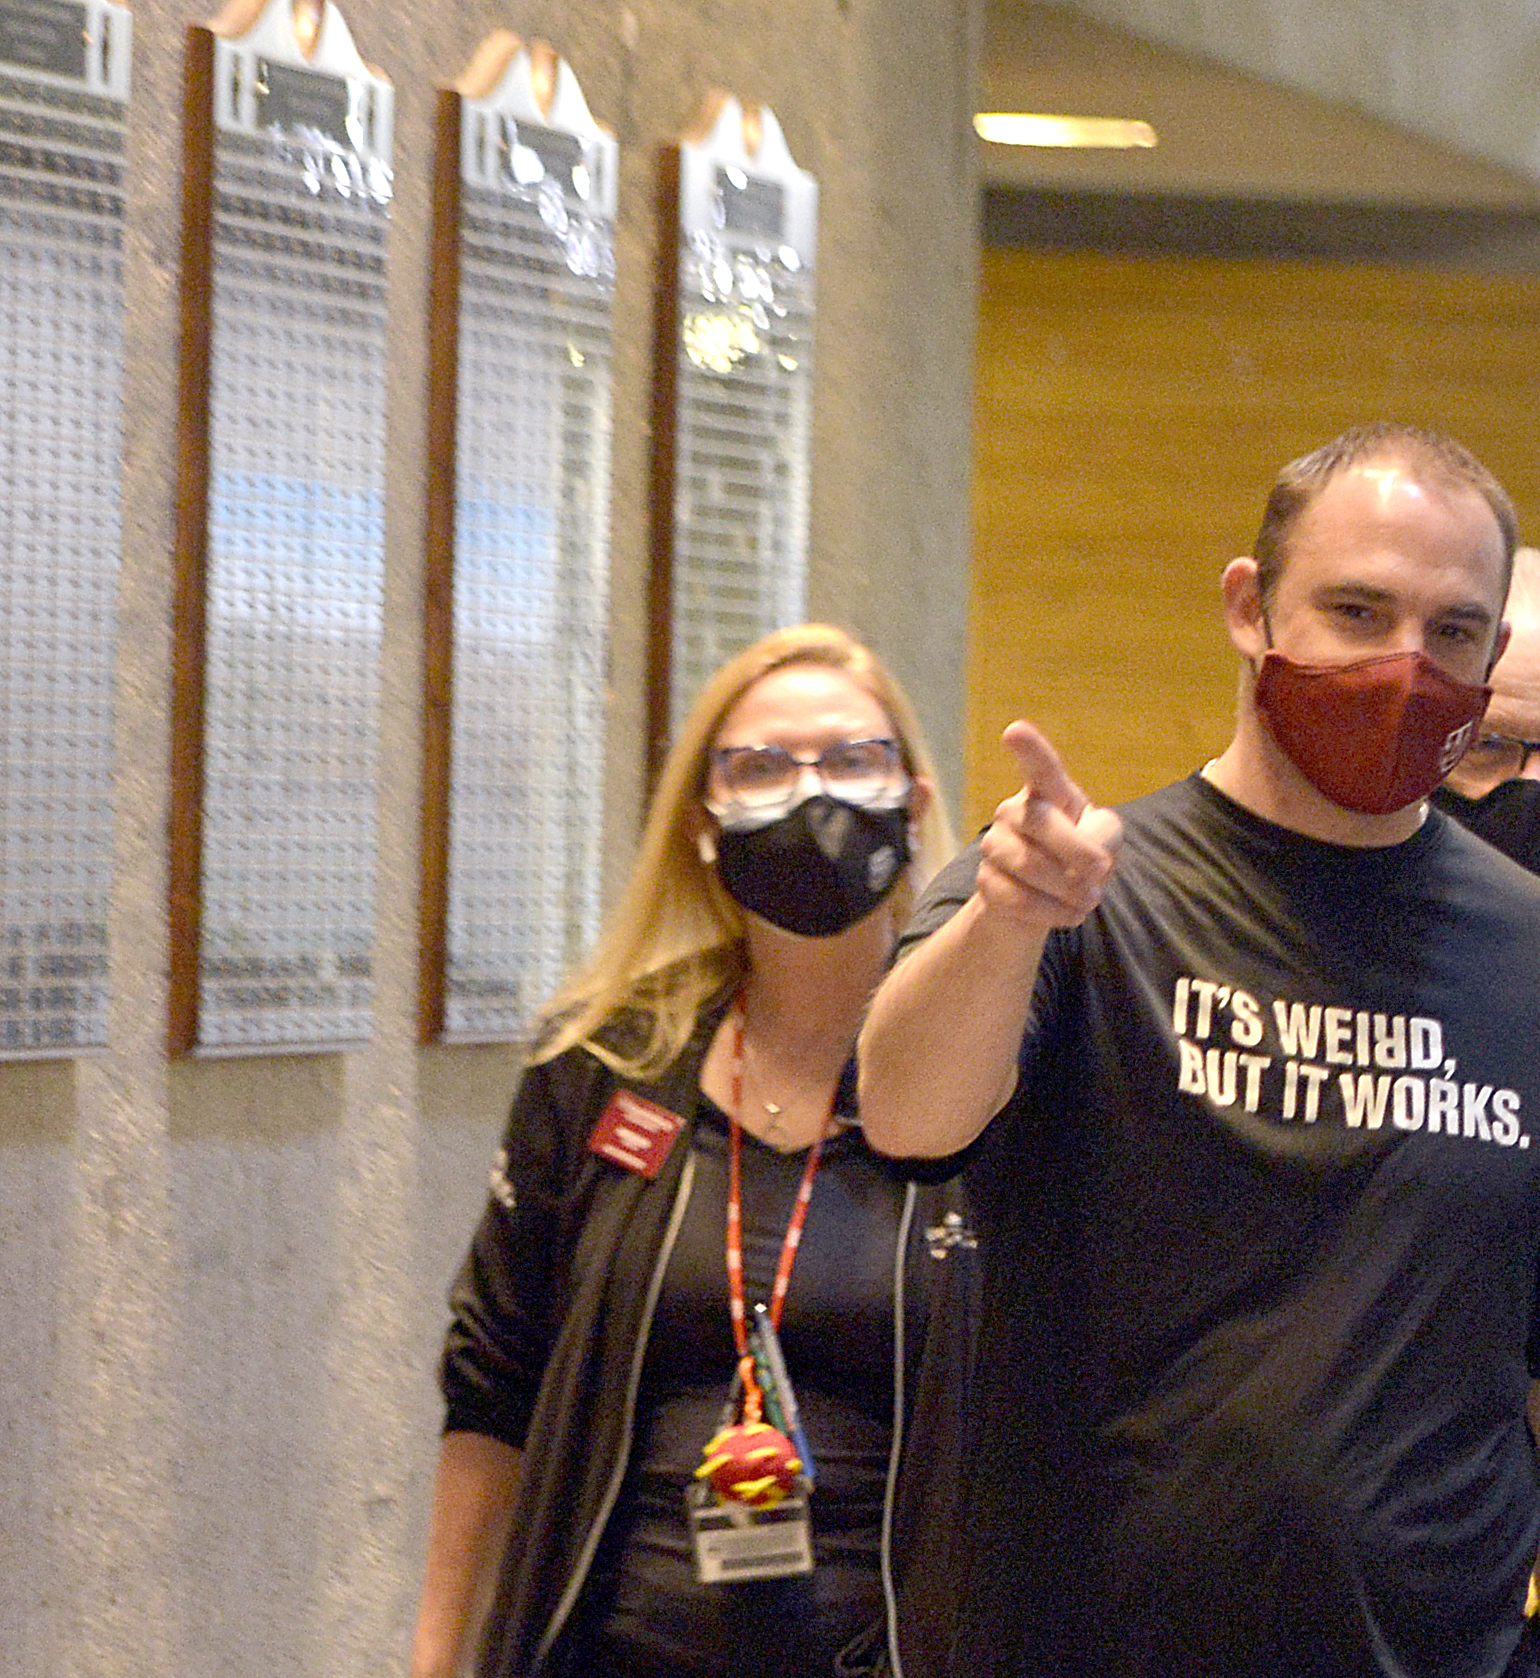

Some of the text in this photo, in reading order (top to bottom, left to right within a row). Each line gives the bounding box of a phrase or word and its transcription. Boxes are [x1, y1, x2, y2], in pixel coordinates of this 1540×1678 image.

[1174, 977, 1264, 1047] IT'S
[1178, 1039, 1532, 1149] BUT IT WORKS.
